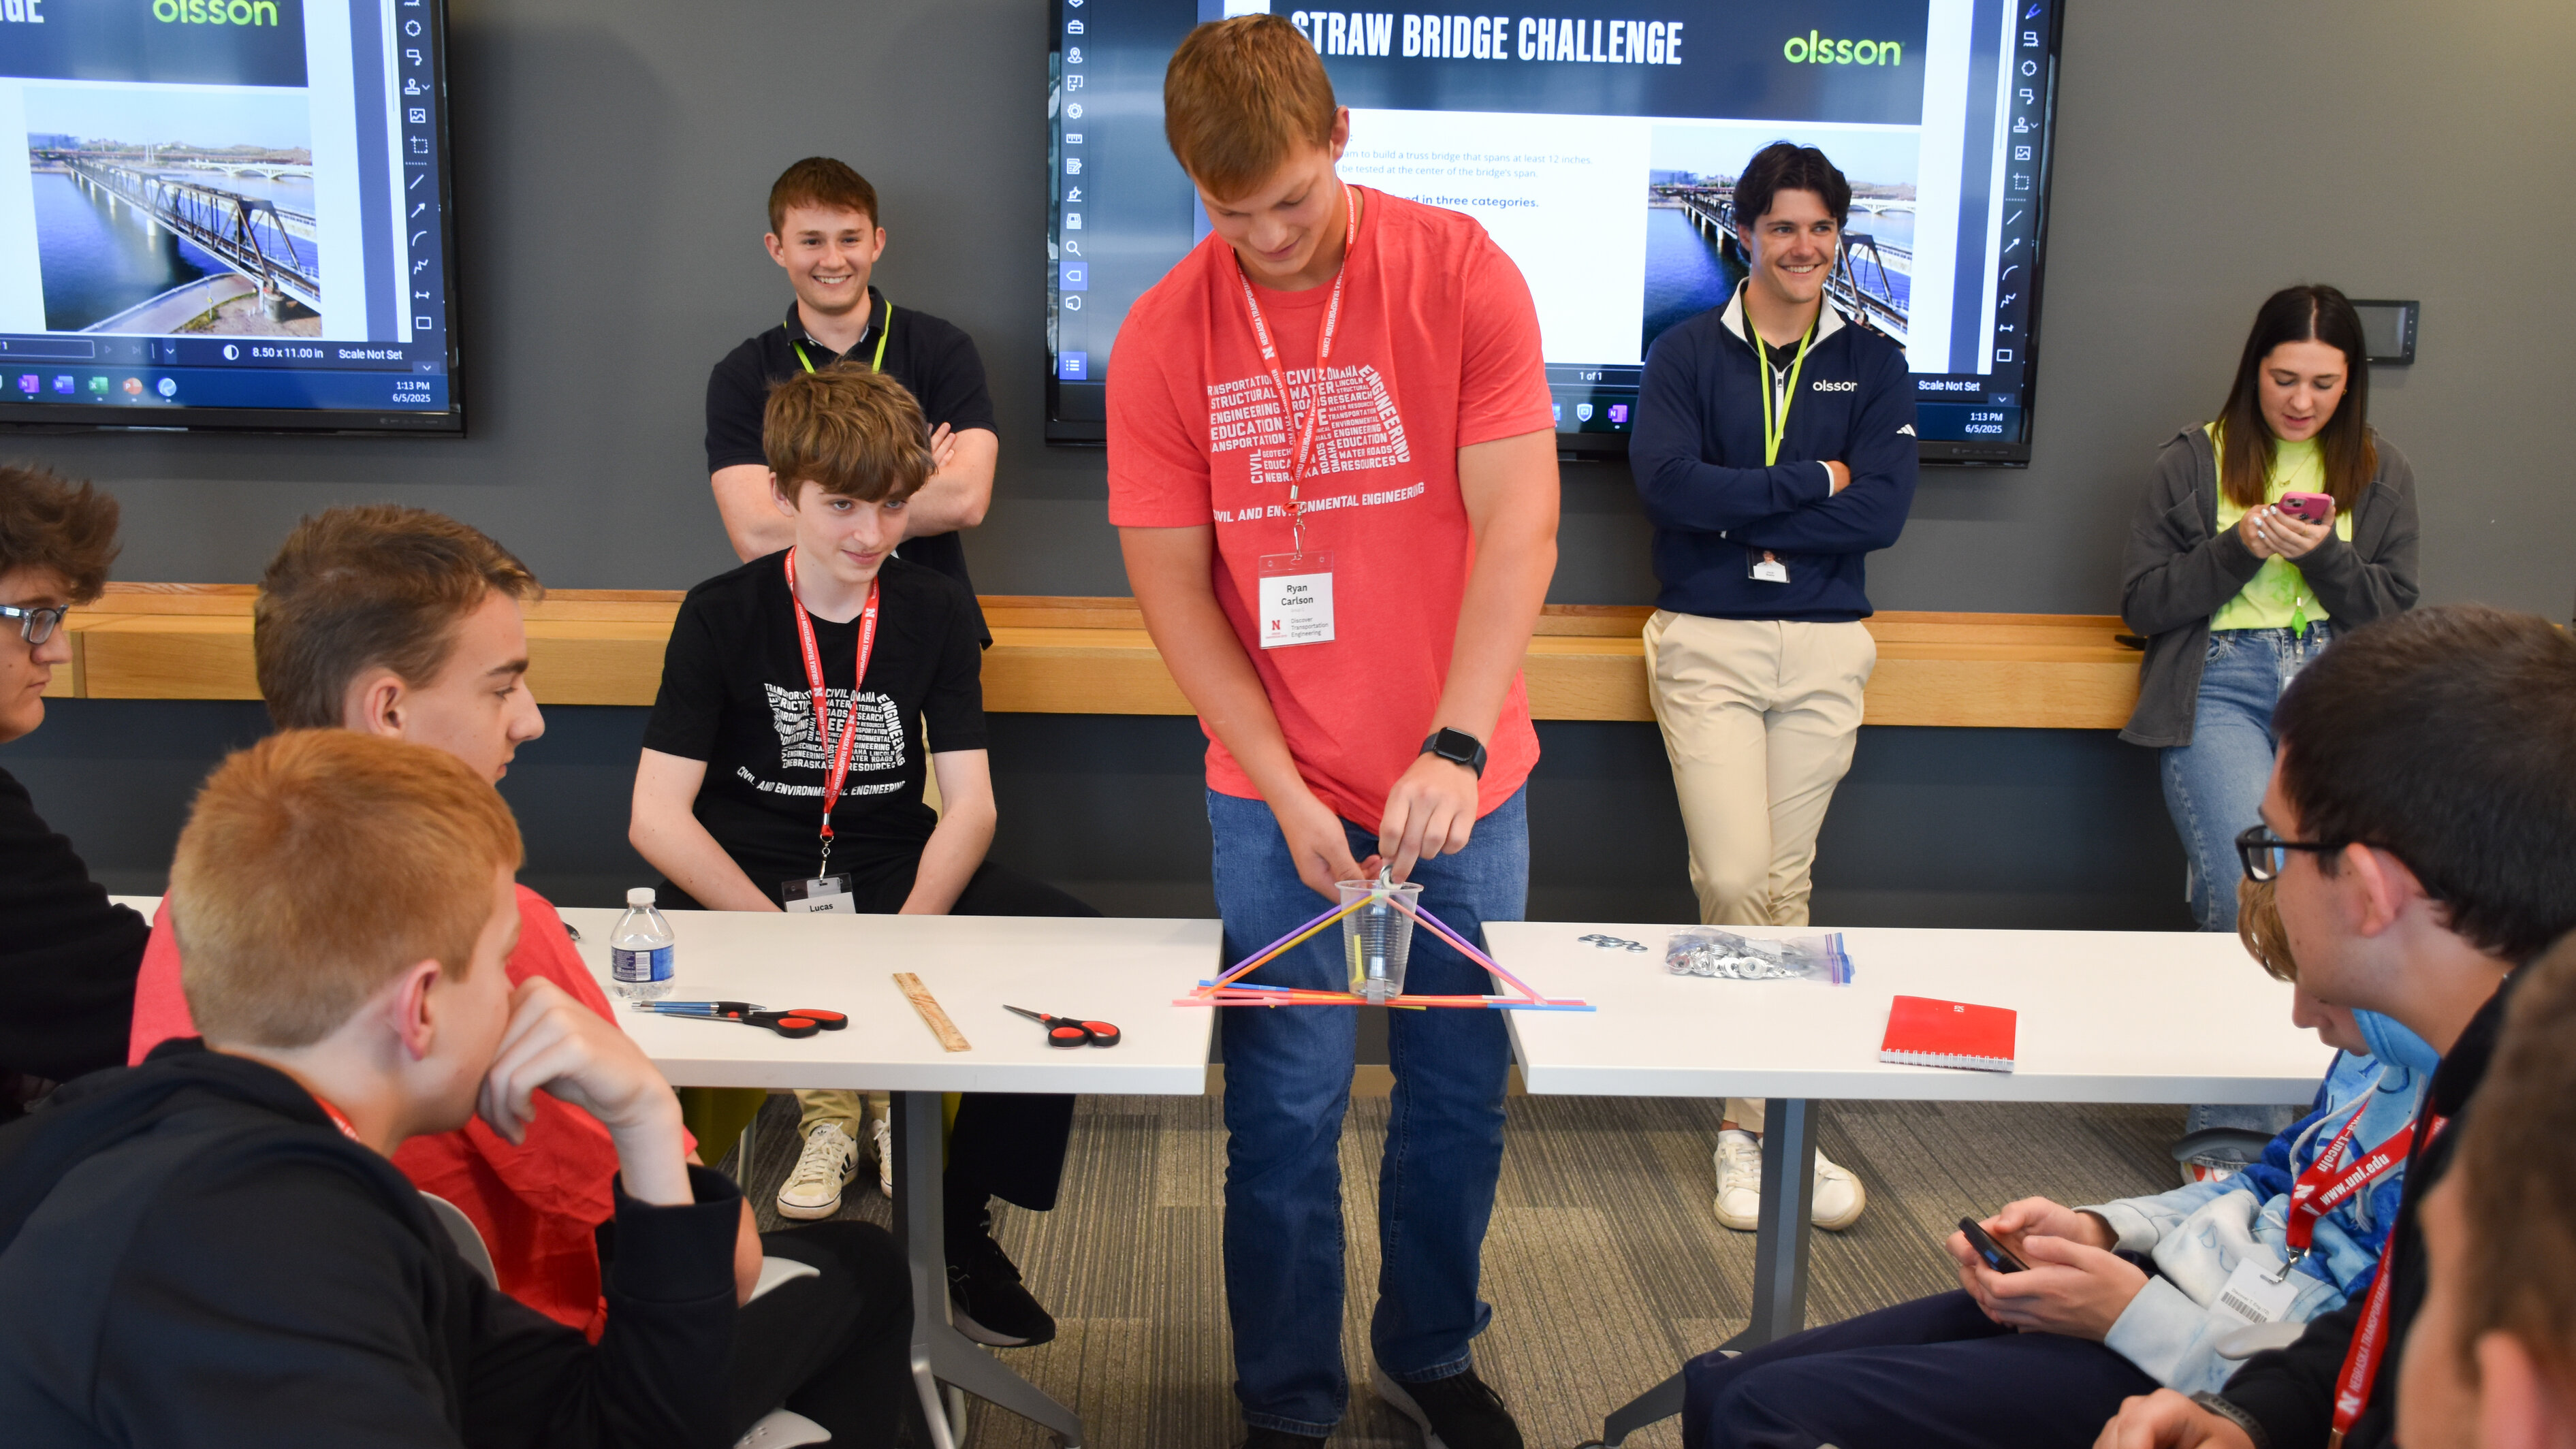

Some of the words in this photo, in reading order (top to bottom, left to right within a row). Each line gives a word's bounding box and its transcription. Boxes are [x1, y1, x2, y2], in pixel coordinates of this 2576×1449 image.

[153, 0, 278, 26] olsson
[1291, 11, 1393, 57] STRAW
[1403, 14, 1509, 60] BRIDGE
[1518, 17, 1683, 65] CHALLENGE
[1783, 29, 1901, 66] olsson
[1373, 150, 1395, 159] build
[1431, 152, 1460, 163] bridge
[1463, 153, 1481, 161] that
[1484, 154, 1510, 163] spans
[1513, 155, 1522, 163] at
[1525, 155, 1545, 163] least
[1549, 155, 1559, 163] 12
[1562, 155, 1592, 164] inches.
[1342, 164, 1353, 172] be
[1356, 165, 1384, 174] tested
[1447, 167, 1456, 175] of
[1459, 168, 1473, 176] the
[1514, 170, 1538, 178] span.
[1422, 195, 1433, 204] in
[1437, 195, 1468, 205] three
[1472, 197, 1539, 208] categories.
[1325, 289, 1339, 336] TRANSPORTATION
[1254, 317, 1269, 346] NEBRASKA
[253, 347, 274, 357] 8.50
[285, 348, 313, 358] 11.00
[315, 348, 323, 358] in
[1262, 346, 1275, 360] N
[1322, 337, 1331, 357] CENTER
[339, 349, 365, 359] Scale
[367, 350, 385, 360] Not
[387, 349, 402, 360] Set
[1271, 368, 1283, 389] CENTER
[1327, 365, 1358, 381] OMAHA
[1580, 372, 1583, 380] 1
[1587, 372, 1596, 381] of
[1597, 372, 1602, 381] 1
[396, 381, 414, 390] 1:13
[417, 382, 430, 390] PM
[1335, 377, 1363, 387] LINCOLN
[1918, 380, 1944, 391] Scale
[1945, 381, 1962, 391] Not
[1965, 381, 1980, 391] Set
[1290, 381, 1335, 400] WATER
[1336, 385, 1369, 394] STRUCTURAL
[393, 394, 430, 402] 6/5/2025
[1211, 387, 1277, 410] STRUCTURAL
[1328, 391, 1373, 405] RESEARCH
[1348, 400, 1374, 409] RESOURCES
[1210, 402, 1280, 425] ENGINEERING
[1328, 409, 1376, 420] TRANSPORTATION
[1971, 413, 1988, 421] 1:13
[1990, 413, 2003, 421] PM
[1211, 417, 1284, 441] EDUCATION
[1331, 416, 1379, 429] ENVIRONMENTAL
[1965, 424, 2002, 433] 6/5/2025
[1333, 424, 1381, 438] ENGINEERING
[1211, 432, 1286, 453] ANSPORTATION
[1299, 417, 1314, 463] TRANSPORTATION
[1337, 433, 1387, 449] EDUCATION
[1316, 443, 1330, 474] ROADS
[1326, 441, 1341, 473] OMAHA
[1339, 449, 1365, 459] WATER
[1367, 445, 1392, 456] ROADS
[1250, 449, 1263, 484] CIVIL
[1341, 456, 1396, 471] RESOURCES
[1238, 507, 1262, 522] AND
[1362, 482, 1425, 506] ENGINEERING
[1286, 585, 1307, 594] Ryan
[1282, 596, 1314, 605] Carlson
[797, 603, 806, 620] CENTER
[865, 607, 875, 618] N
[863, 619, 872, 645] NEBRASKA
[1272, 620, 1280, 631] N
[802, 620, 815, 662] TRANSPORTATION
[810, 661, 820, 685] NEBRASKA
[814, 686, 823, 697] N
[825, 688, 849, 698] CIVIL
[827, 709, 848, 718] OADS
[848, 715, 855, 724] N
[856, 712, 884, 722] SEARCH
[808, 718, 816, 741] OMAHA
[828, 718, 845, 732] EE
[842, 726, 853, 752] NEBRASKA
[854, 742, 890, 751] GINEERING
[787, 750, 825, 759] ENGINEERING
[787, 759, 827, 769] NEBRASKA
[833, 751, 848, 791] TRANSPORTATION
[737, 766, 754, 786] CIVIL
[756, 780, 776, 792] AND
[850, 780, 906, 796] ENGINEERING
[810, 904, 833, 912] Lucas
[2319, 1153, 2390, 1206] www.unl.edu
[2361, 1272, 2389, 1348] TRANSPORTATION
[2349, 1346, 2369, 1392] NEBRASKA
[2337, 1390, 2362, 1416] N
